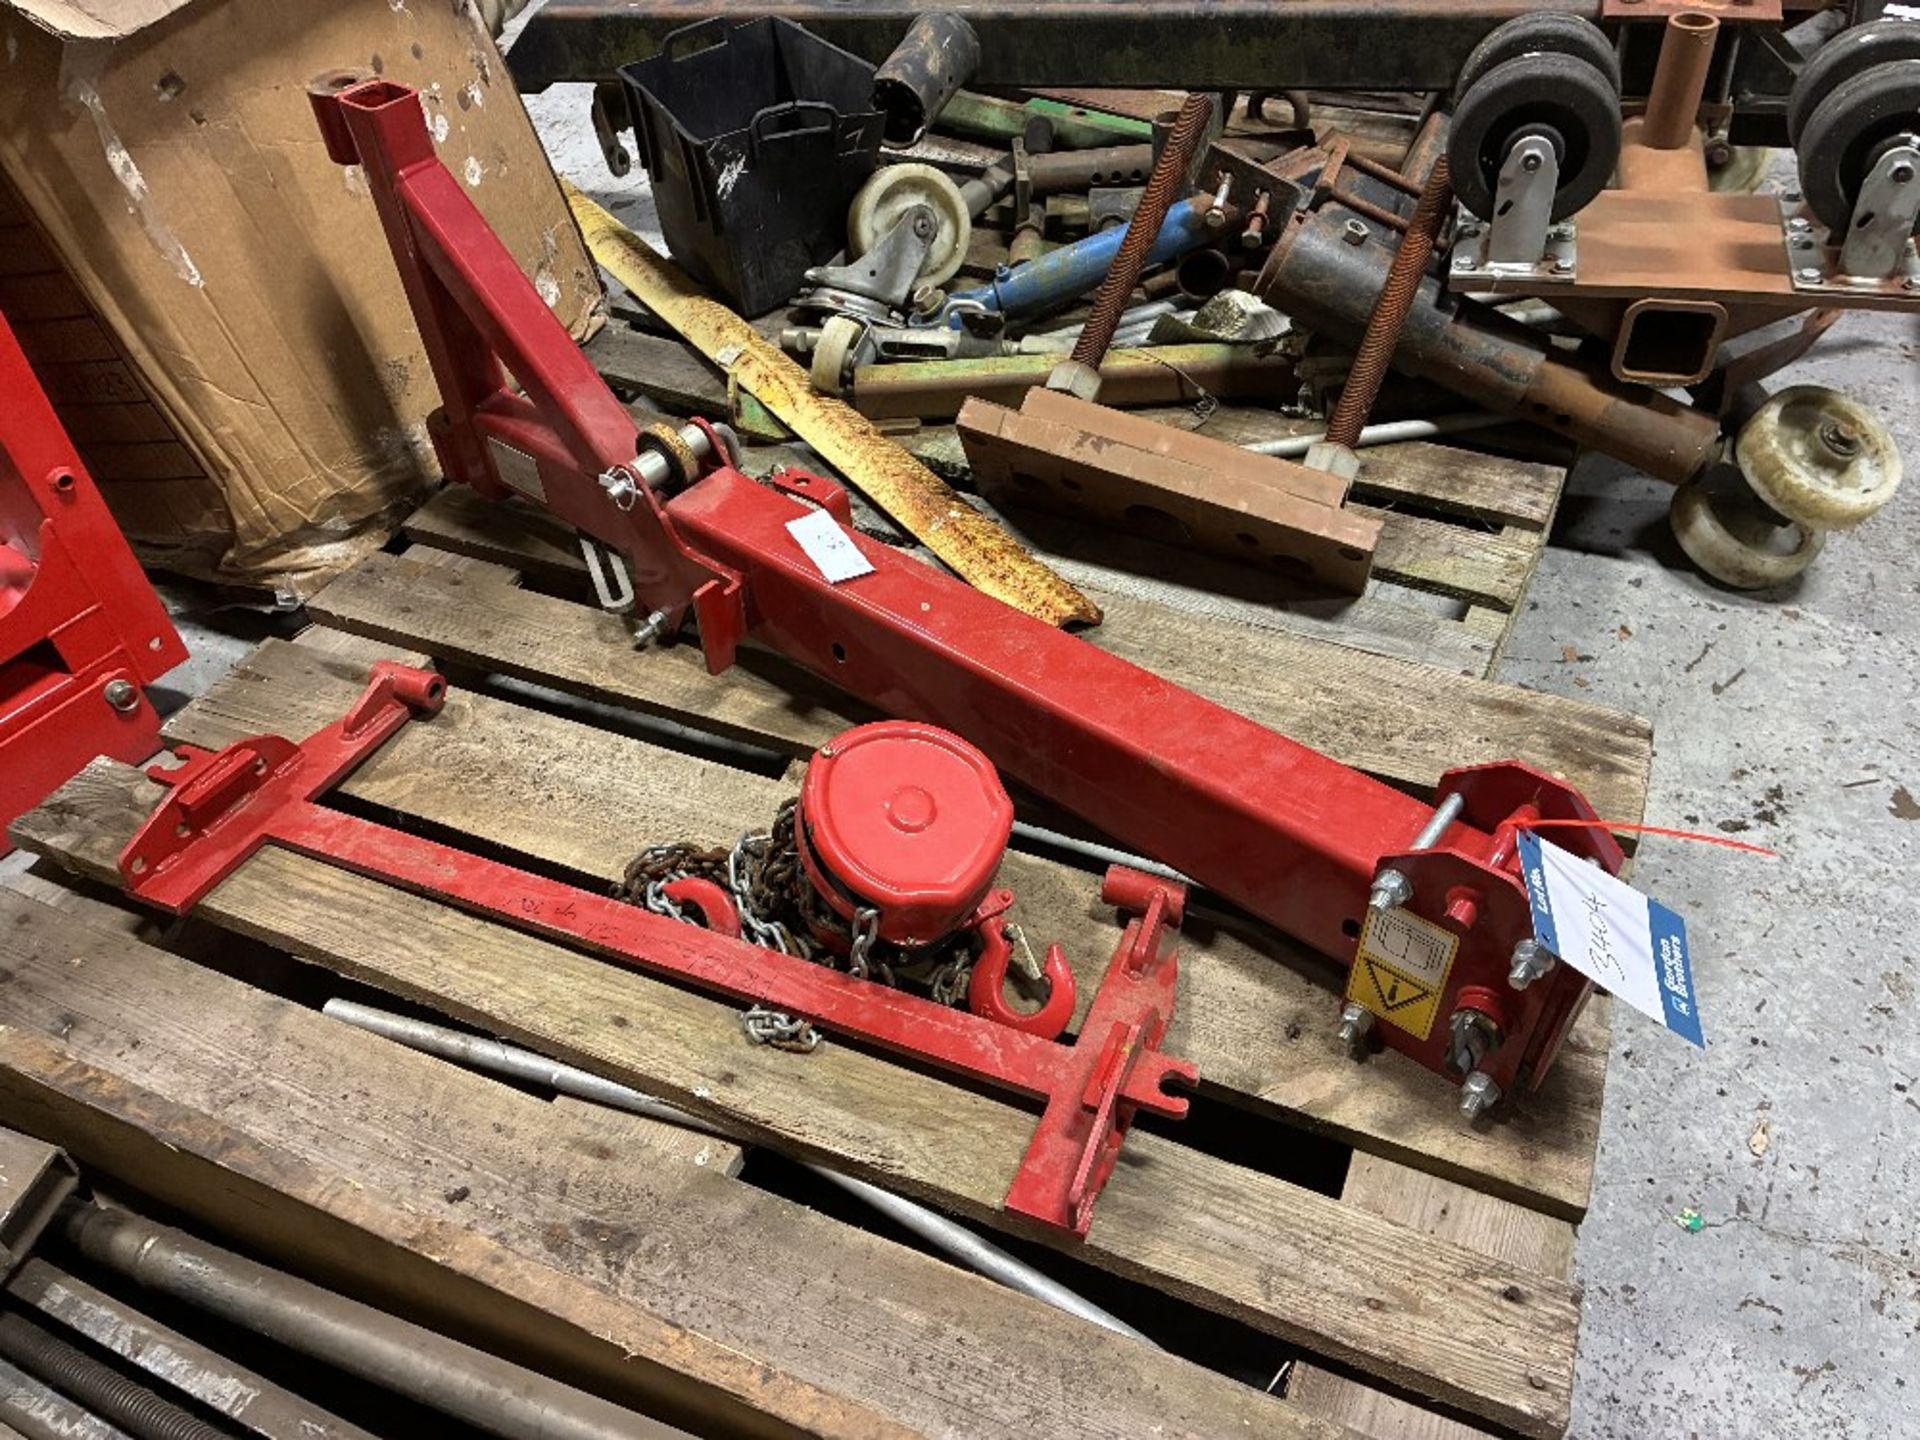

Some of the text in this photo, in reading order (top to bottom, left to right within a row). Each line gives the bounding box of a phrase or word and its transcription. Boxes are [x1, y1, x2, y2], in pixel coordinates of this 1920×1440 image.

[1537, 887, 1549, 914] Lot
[1581, 892, 1626, 982] 3404
[1660, 939, 1675, 991] Gordon
[1671, 935, 1688, 998] Brothers
